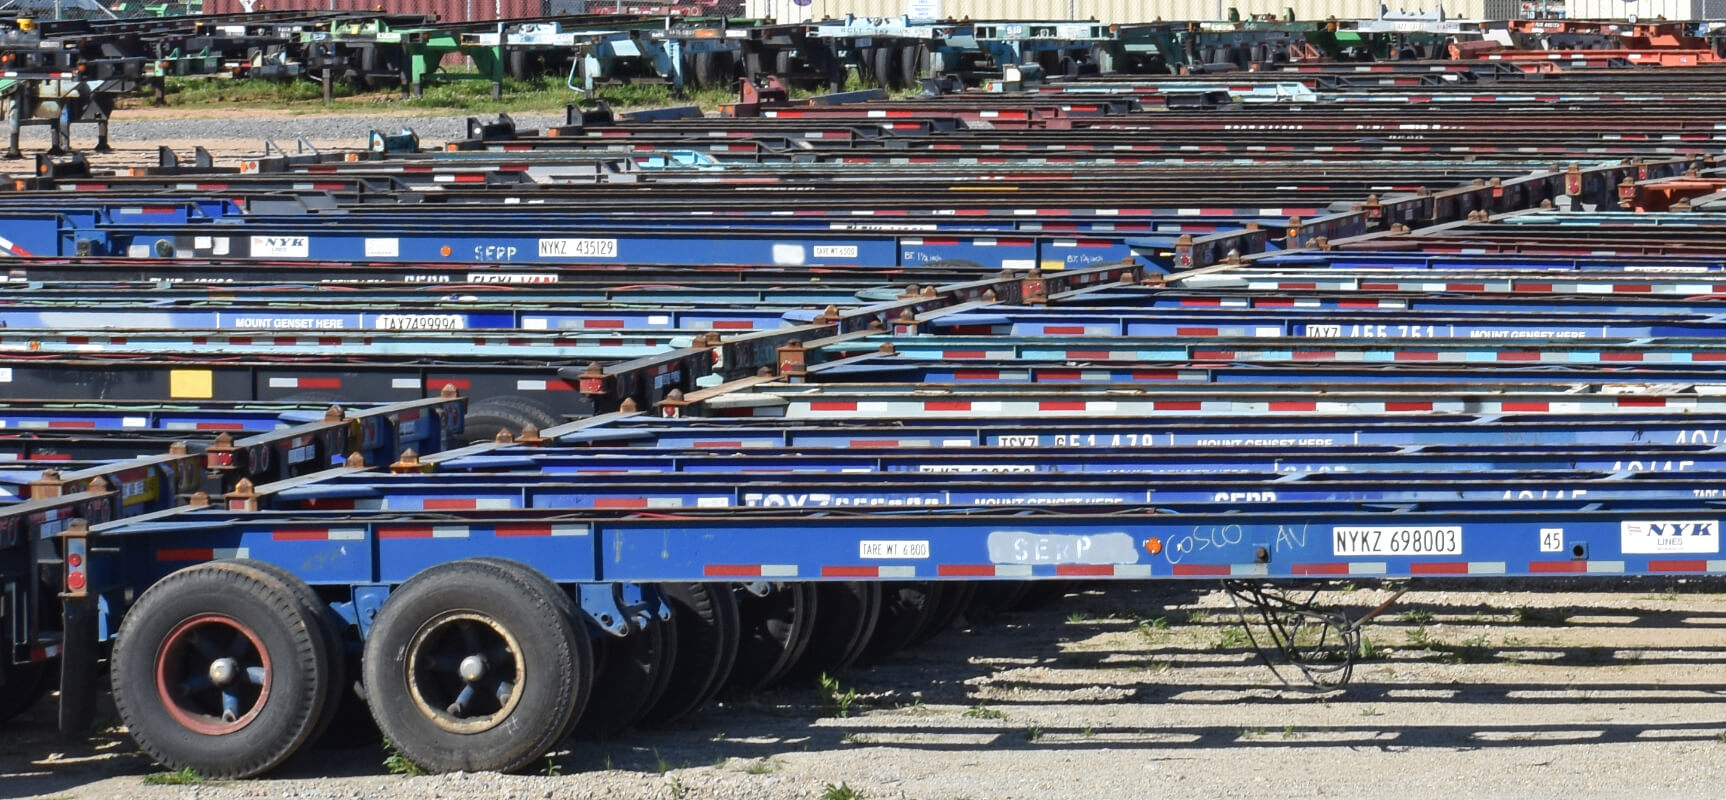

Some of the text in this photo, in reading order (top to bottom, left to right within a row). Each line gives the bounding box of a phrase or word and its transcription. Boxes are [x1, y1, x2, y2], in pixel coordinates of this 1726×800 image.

[265, 238, 304, 247] NYK
[541, 241, 613, 254] NYKZ 435129
[235, 318, 344, 329] MOUNT GENSET HERE
[1646, 523, 1713, 536] NYK
[1336, 530, 1457, 553] NYKZ 698003
[1543, 532, 1561, 551] 45
[1657, 538, 1684, 546] LINES
[863, 543, 883, 556] TARE
